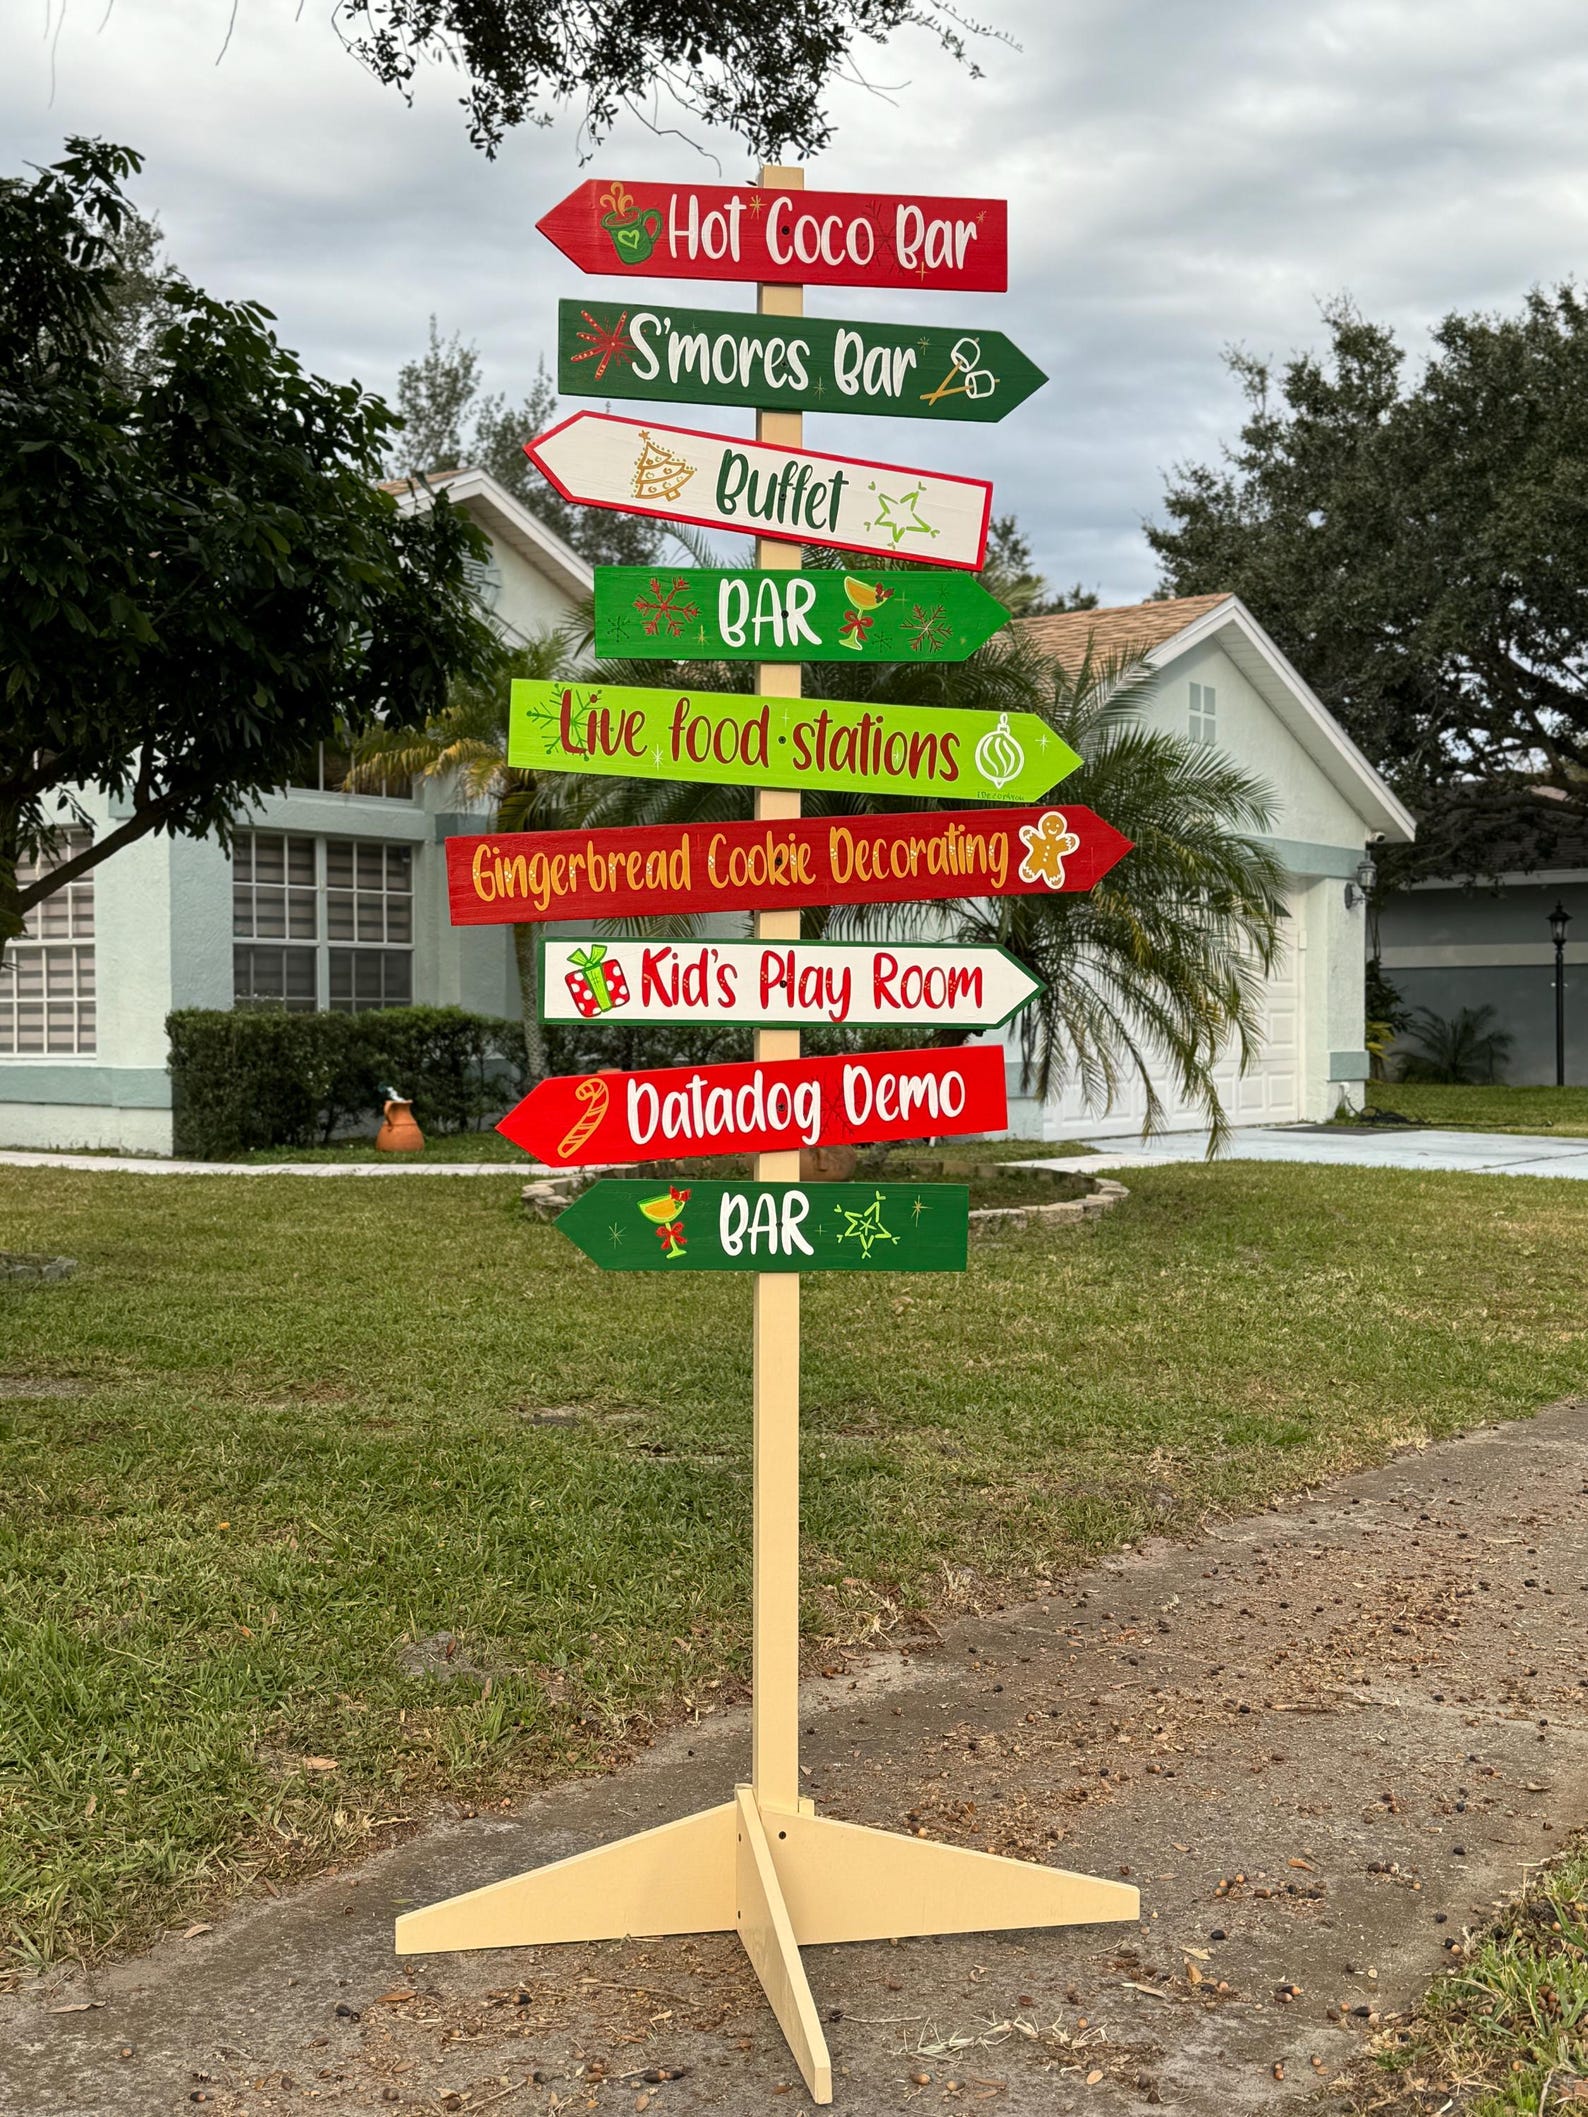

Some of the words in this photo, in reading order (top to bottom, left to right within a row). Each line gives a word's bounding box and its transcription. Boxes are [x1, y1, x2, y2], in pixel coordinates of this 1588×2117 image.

[669, 194, 746, 262] Hot
[766, 196, 875, 266] Coco
[896, 204, 978, 270] Bar
[629, 312, 811, 391] S'mores
[834, 328, 917, 397] Bar
[716, 448, 849, 534] Buffet
[718, 578, 823, 648] BAR
[560, 688, 648, 758] Live
[669, 697, 771, 768] food
[792, 709, 961, 782] stations
[472, 833, 691, 911] Gingerbread
[708, 833, 816, 888] Cookie
[830, 823, 1009, 888] Decorating
[641, 946, 738, 1009] Kid's
[760, 949, 851, 1023] Play
[873, 952, 983, 1010] Room
[626, 1069, 822, 1146] Datadog
[842, 1063, 966, 1126] Demo
[719, 1189, 815, 1256] BAR
